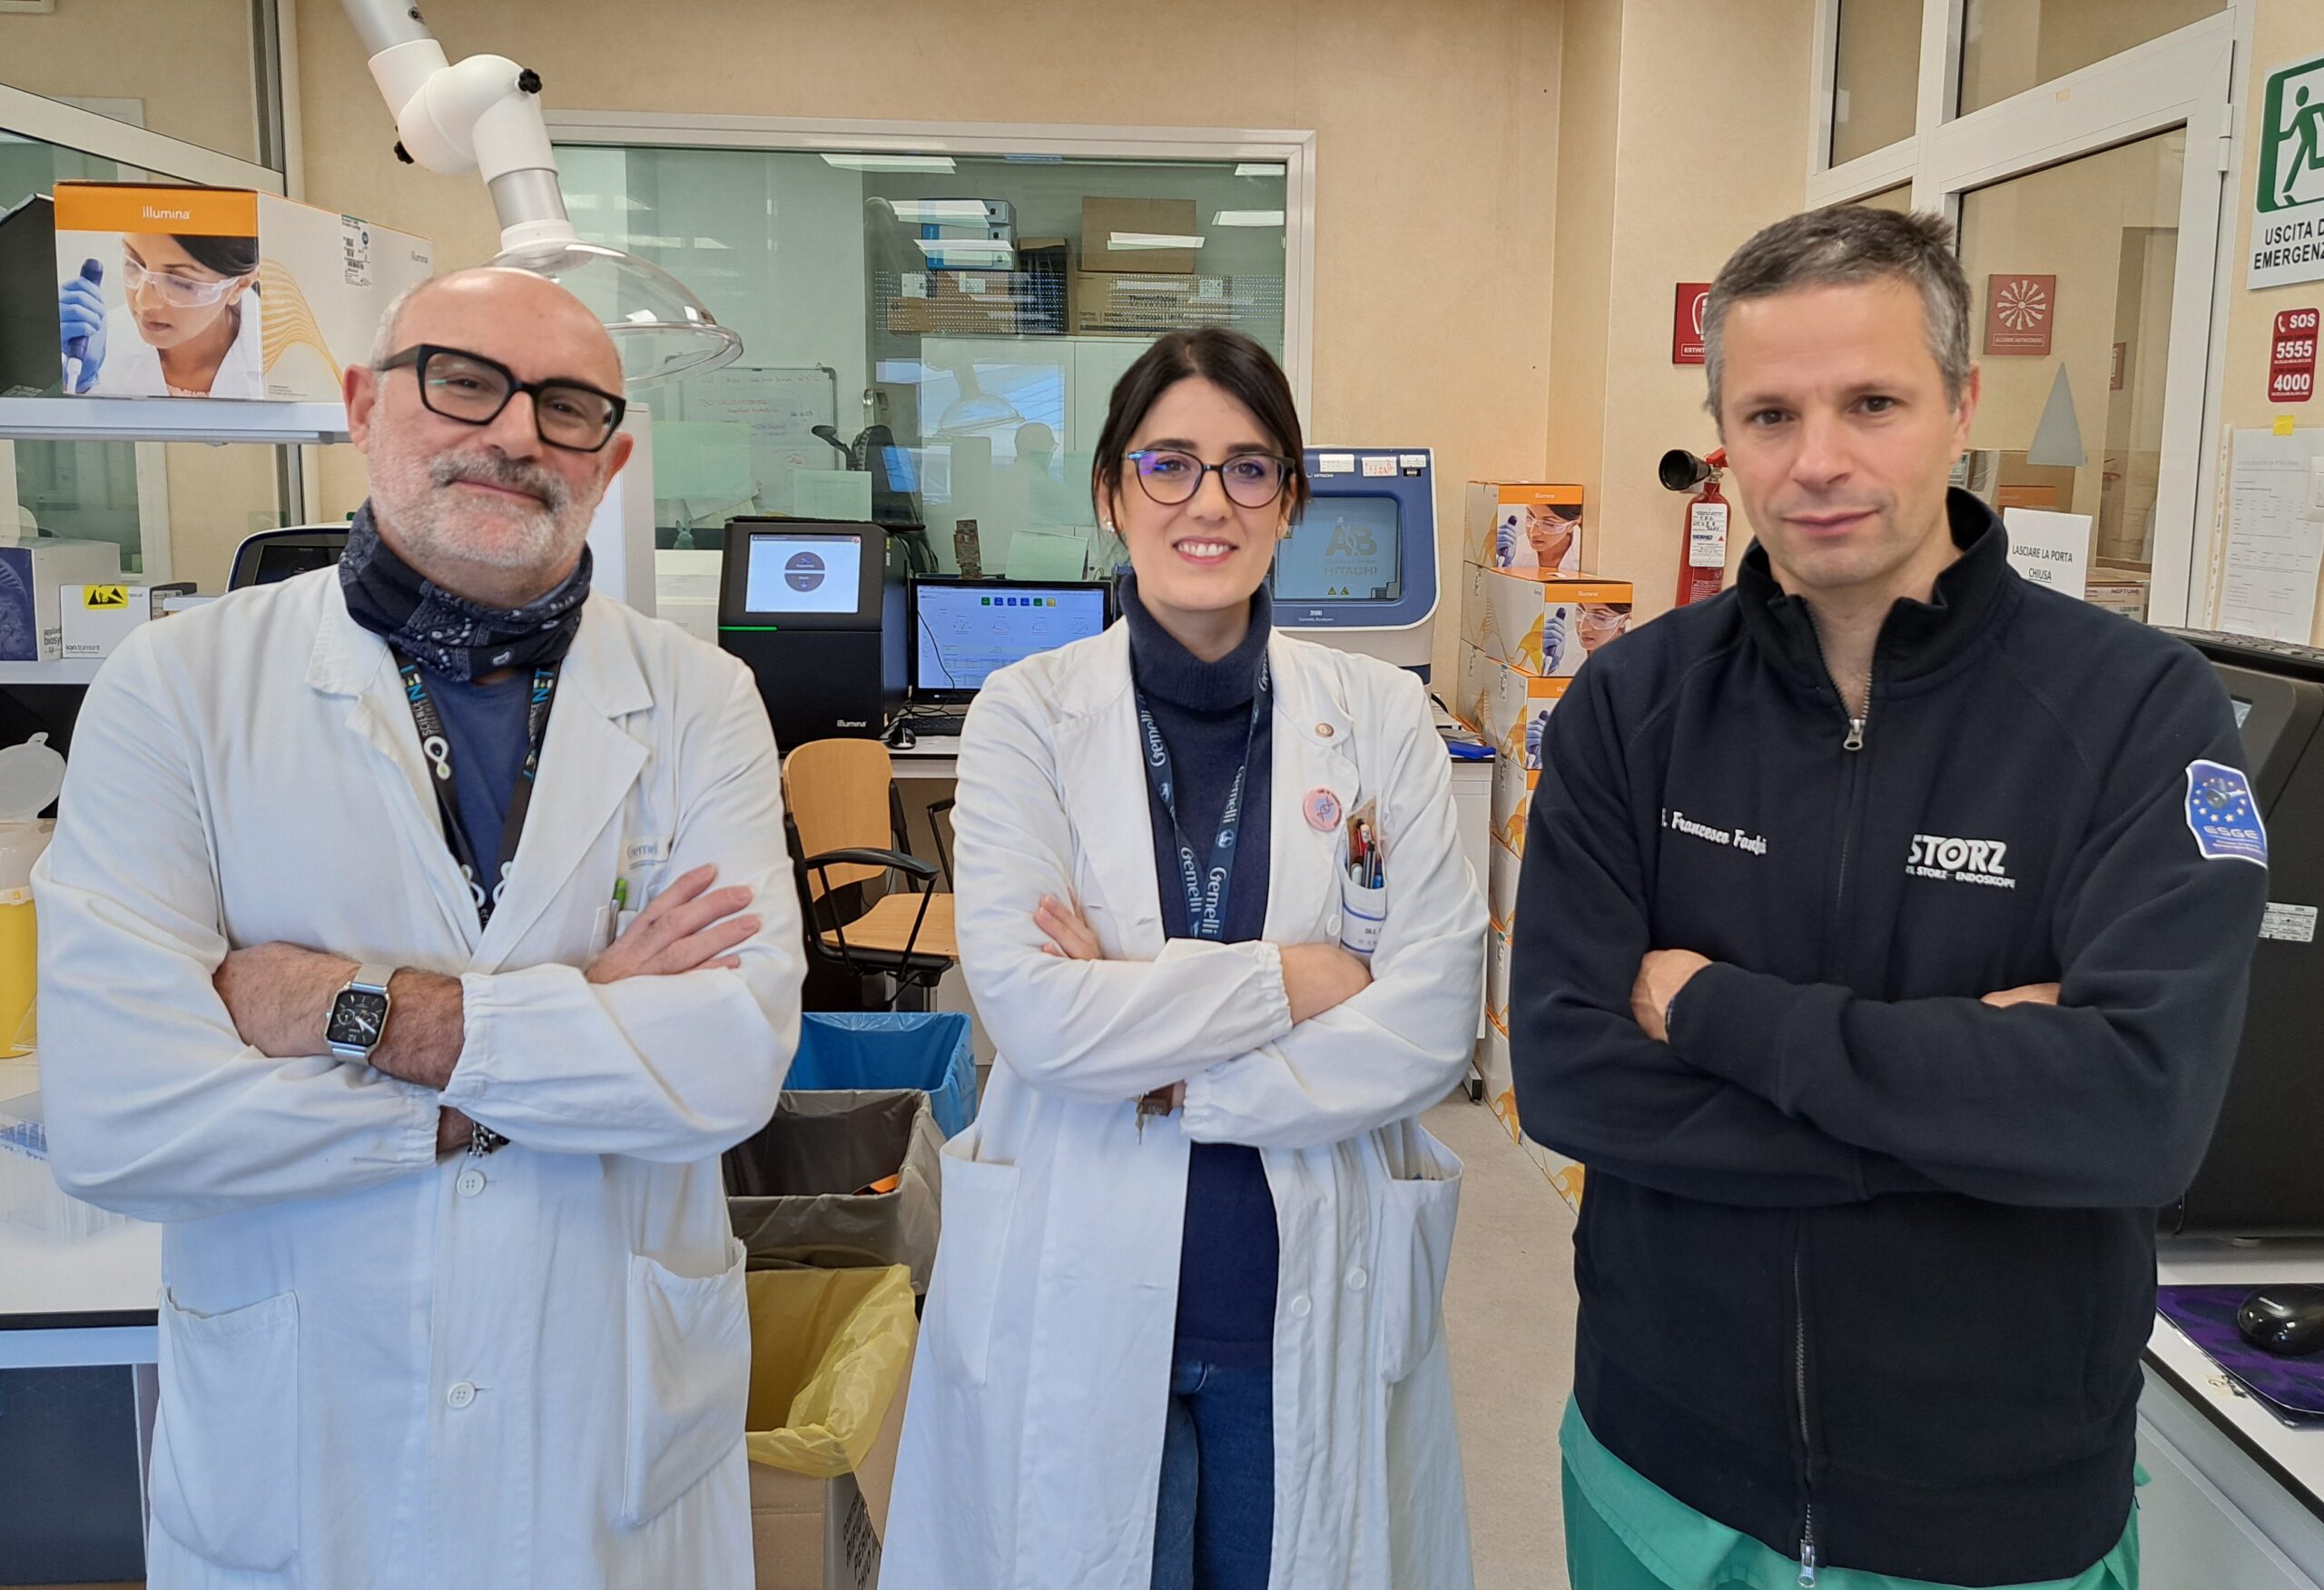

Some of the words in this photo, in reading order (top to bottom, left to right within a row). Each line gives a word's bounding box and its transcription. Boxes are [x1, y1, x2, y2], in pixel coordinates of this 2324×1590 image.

[143, 203, 190, 220] illumina
[2265, 221, 2312, 245] USCITA
[2289, 313, 2316, 329] SOS
[2276, 341, 2313, 359] 5555
[2273, 373, 2310, 391] 4000
[2013, 545, 2041, 558] LASCIARE
[2042, 548, 2050, 559] LA
[2051, 550, 2073, 563] PORTA
[1324, 566, 1377, 576] HITACHI
[2028, 568, 2052, 580] CHIUSA
[836, 719, 868, 727] illumina
[1139, 709, 1167, 767] Gemelli
[1671, 811, 1730, 844] Francesco
[2203, 825, 2259, 840] ESGE
[1907, 835, 2007, 875] STORZ
[1180, 846, 1205, 913] Gemelli
[1916, 866, 1947, 880] STORZ
[1201, 866, 1227, 935] Gemelli
